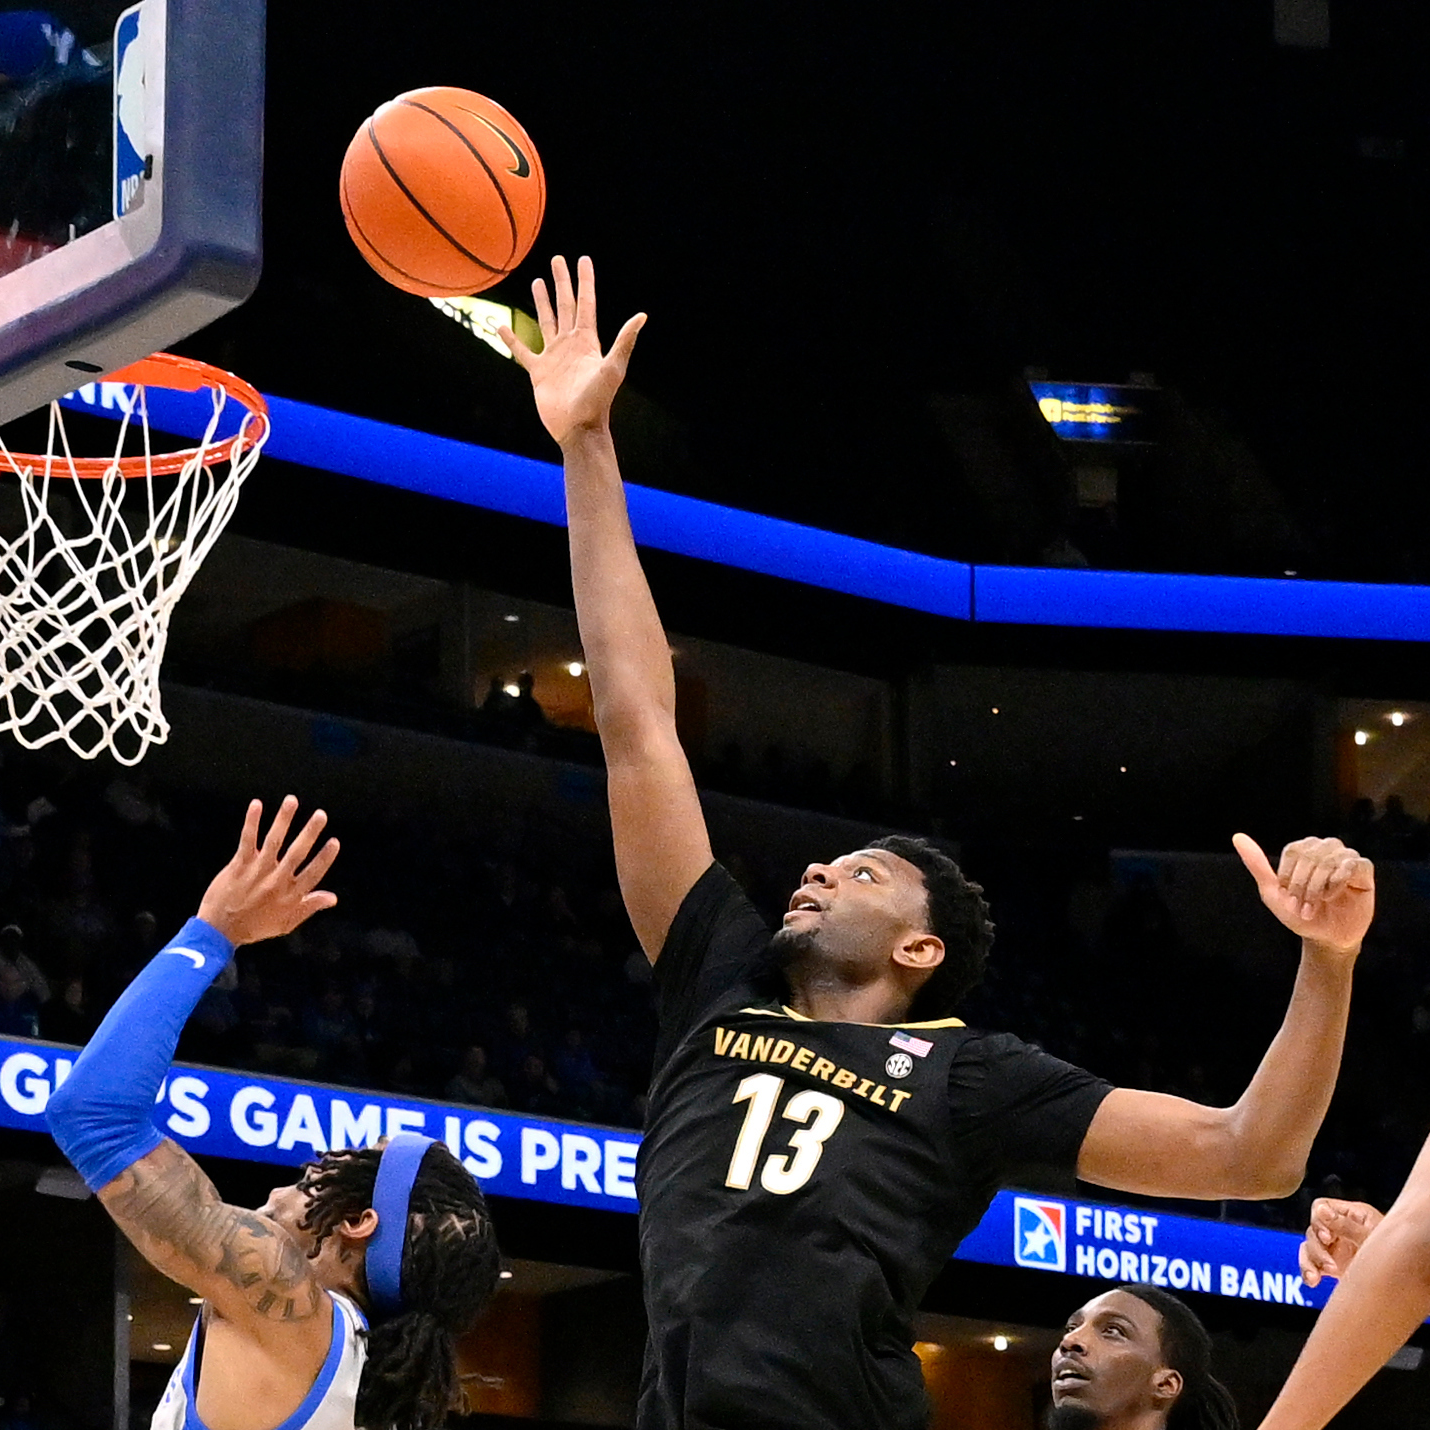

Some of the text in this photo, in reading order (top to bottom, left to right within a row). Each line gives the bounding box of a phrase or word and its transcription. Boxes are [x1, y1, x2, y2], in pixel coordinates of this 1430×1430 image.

[713, 1027, 912, 1113] VANDERBILT
[725, 1072, 846, 1196] 13
[1075, 1206, 1159, 1246] FIRST
[1075, 1244, 1212, 1293] HORIZON
